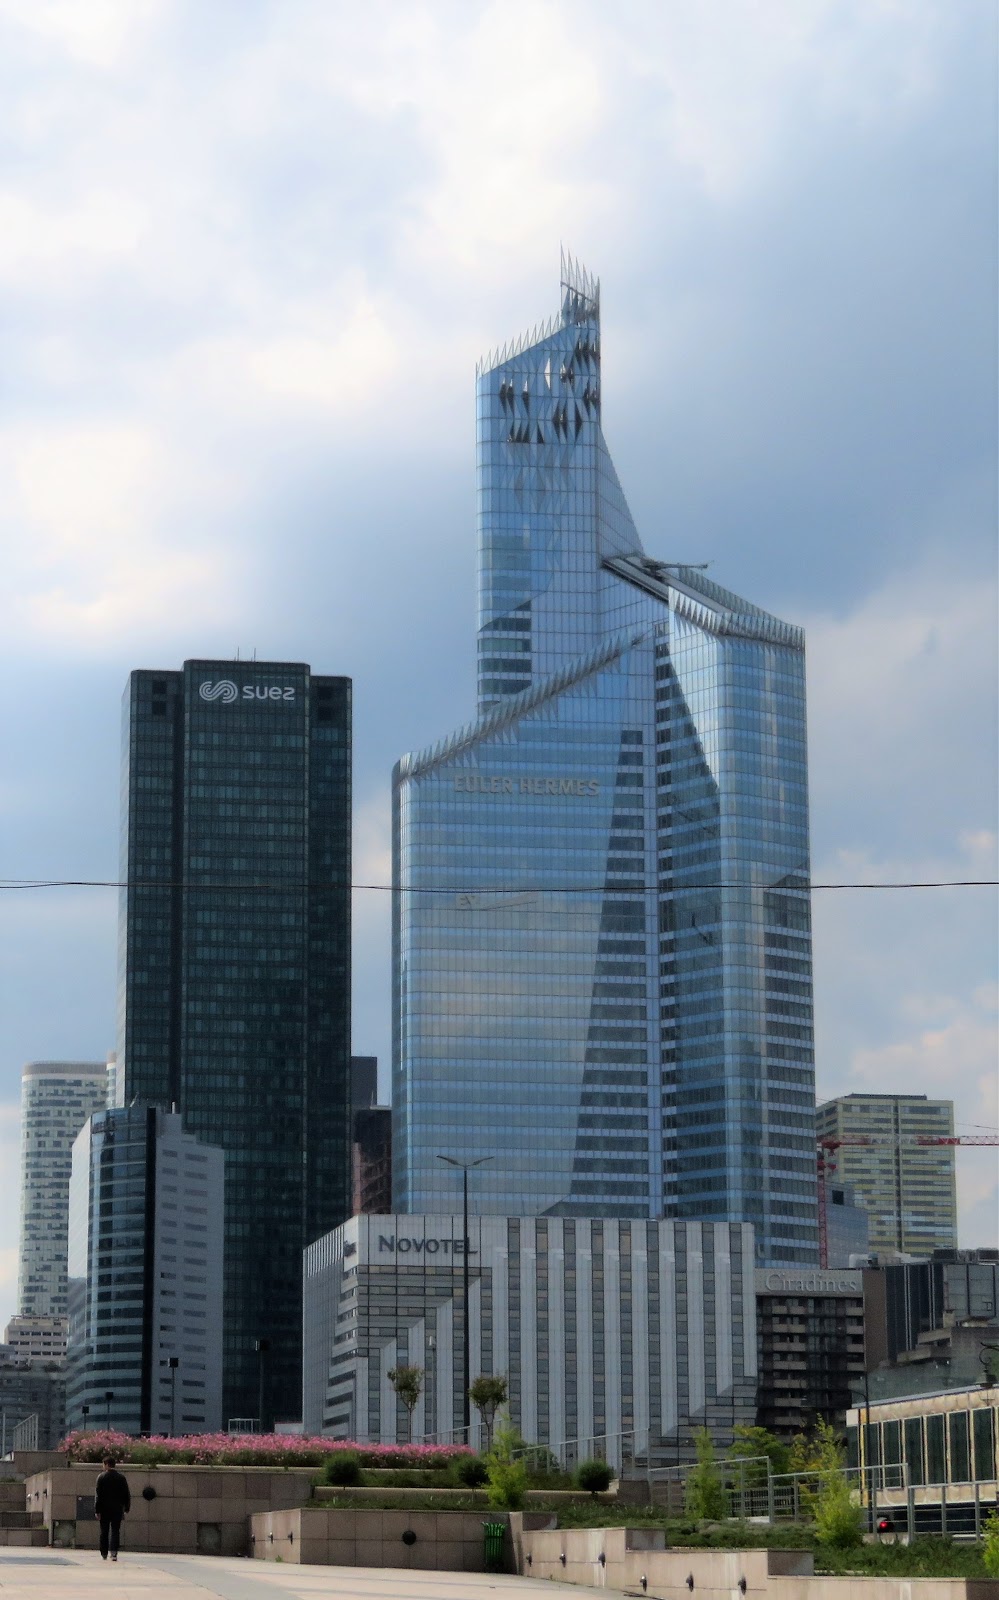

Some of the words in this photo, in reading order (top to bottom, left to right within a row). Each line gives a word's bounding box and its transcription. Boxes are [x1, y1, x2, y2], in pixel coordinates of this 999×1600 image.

[242, 685, 295, 700] suez
[454, 775, 513, 794] EULER
[519, 777, 600, 797] HERMES
[378, 1235, 478, 1254] NOVOTEL
